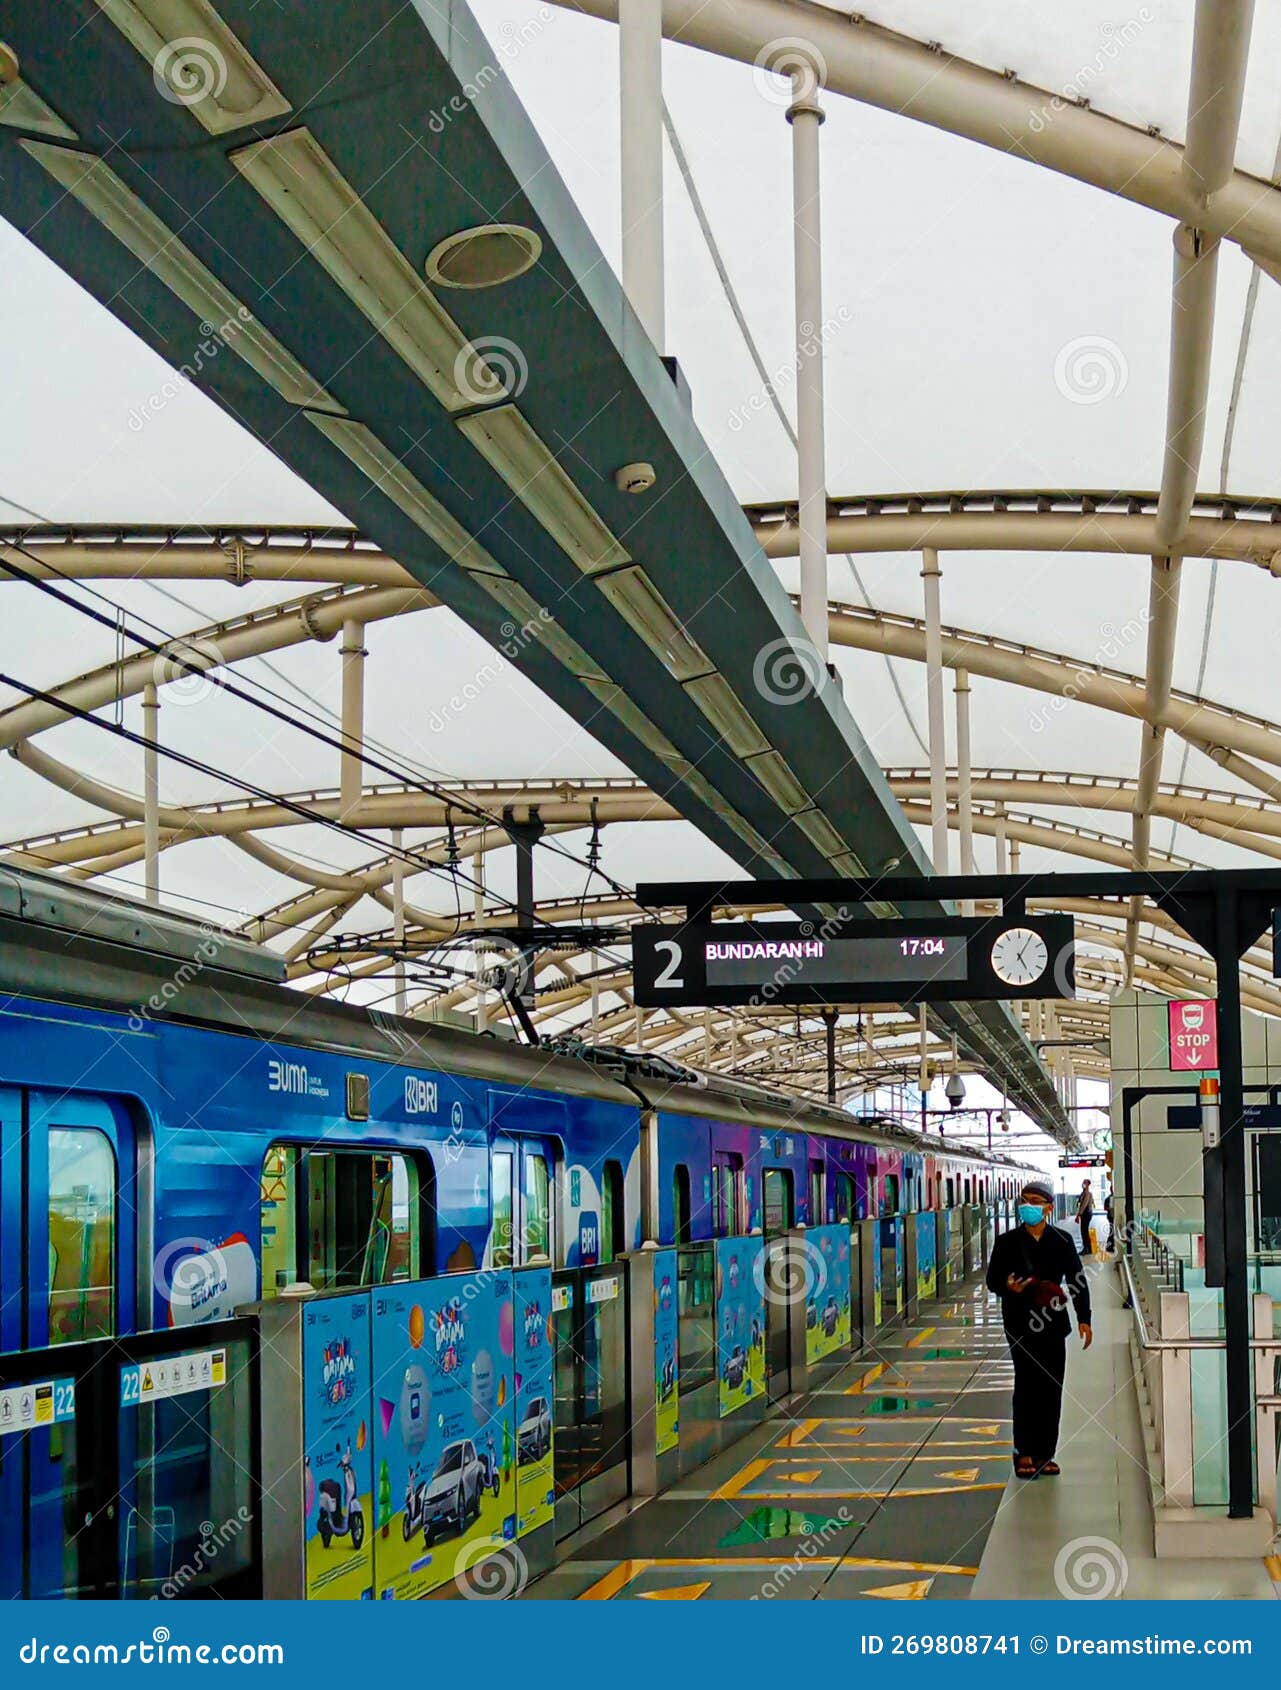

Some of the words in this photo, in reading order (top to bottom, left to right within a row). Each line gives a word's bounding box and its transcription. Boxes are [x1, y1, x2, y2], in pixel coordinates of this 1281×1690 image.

[705, 942, 802, 960] BUNDARAN
[805, 941, 824, 958] HI
[900, 940, 945, 956] 17:04
[653, 940, 684, 988] 2
[1177, 1034, 1210, 1047] STOP
[418, 1077, 438, 1113] BRI
[581, 1227, 596, 1254] BRI
[56, 1384, 75, 1415] 22
[123, 1371, 139, 1400] 22
